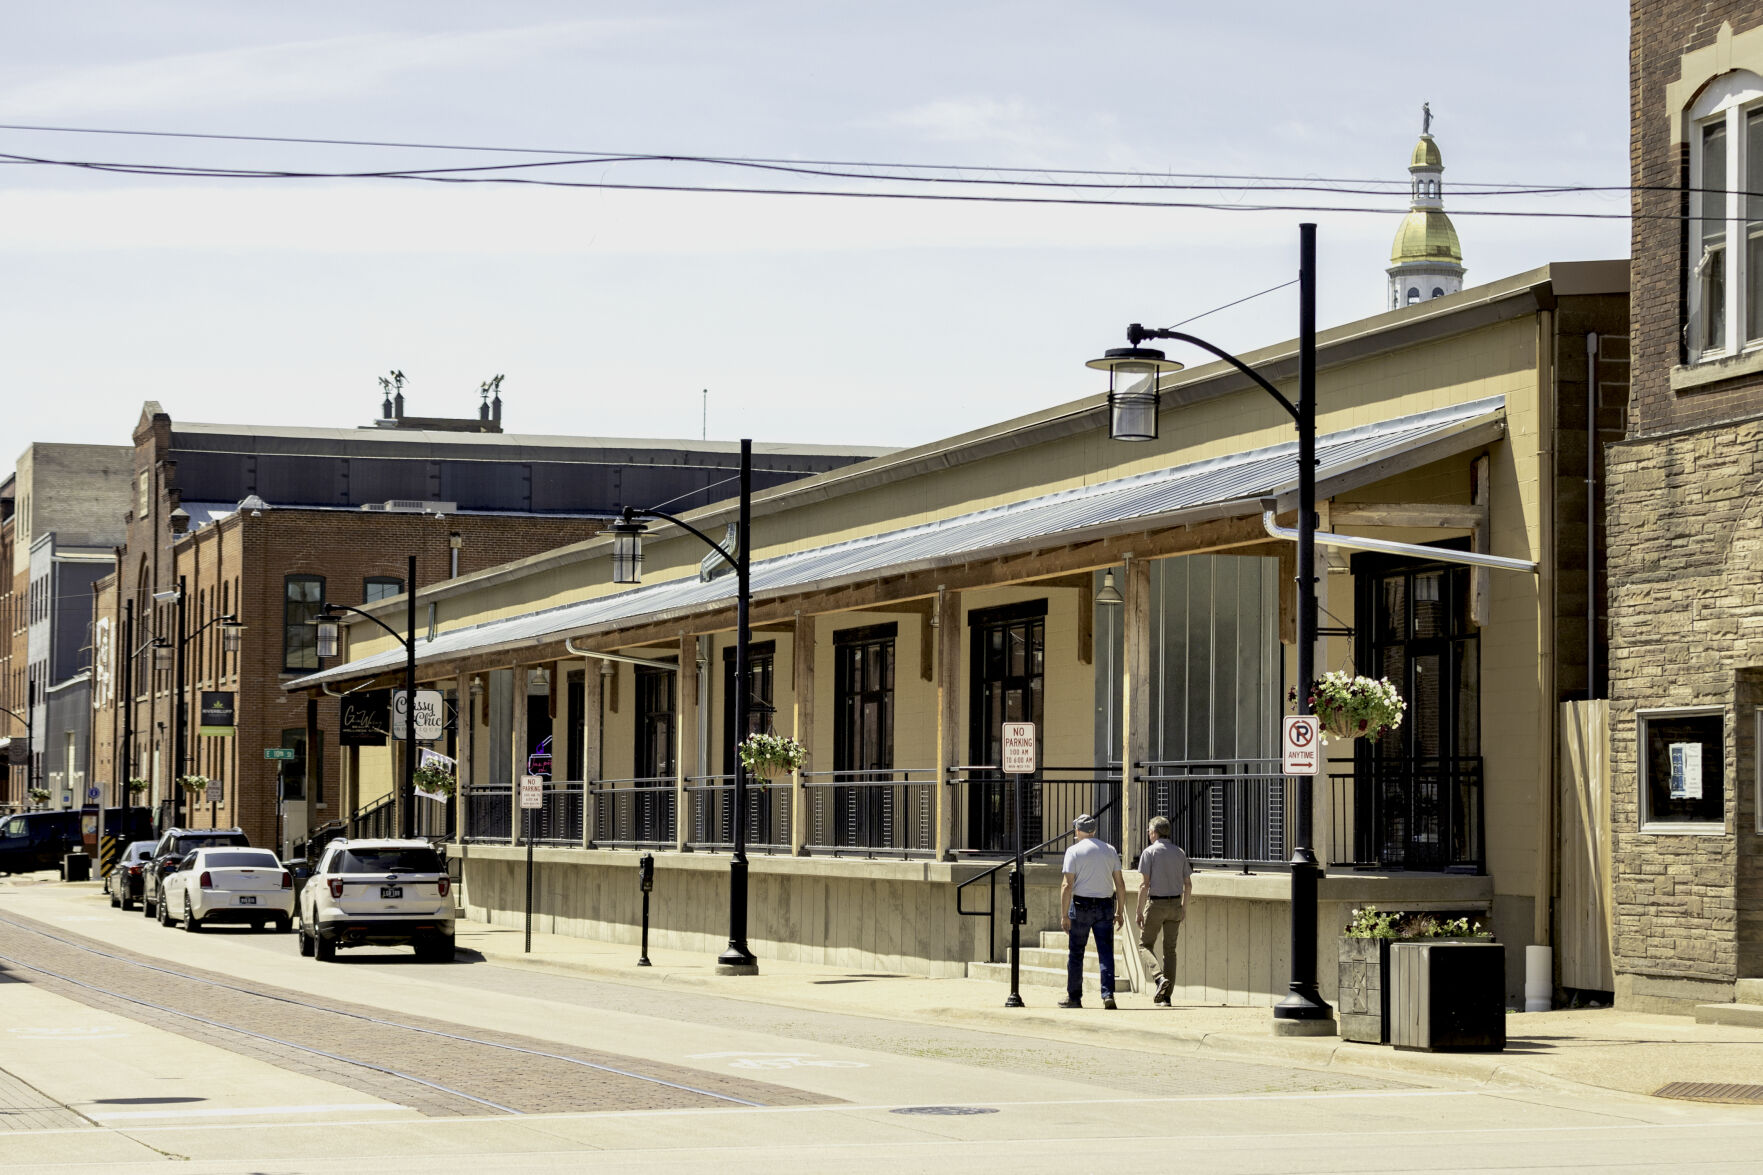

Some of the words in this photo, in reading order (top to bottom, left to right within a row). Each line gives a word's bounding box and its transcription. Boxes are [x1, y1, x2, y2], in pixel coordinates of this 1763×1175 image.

[395, 696, 436, 717] Cssy
[415, 711, 442, 727] Chic
[1013, 727, 1025, 737] NO
[1005, 738, 1033, 748] PARKING
[1021, 748, 1029, 756] AM
[1288, 751, 1315, 759] ANYTIME
[1025, 756, 1033, 764] AM
